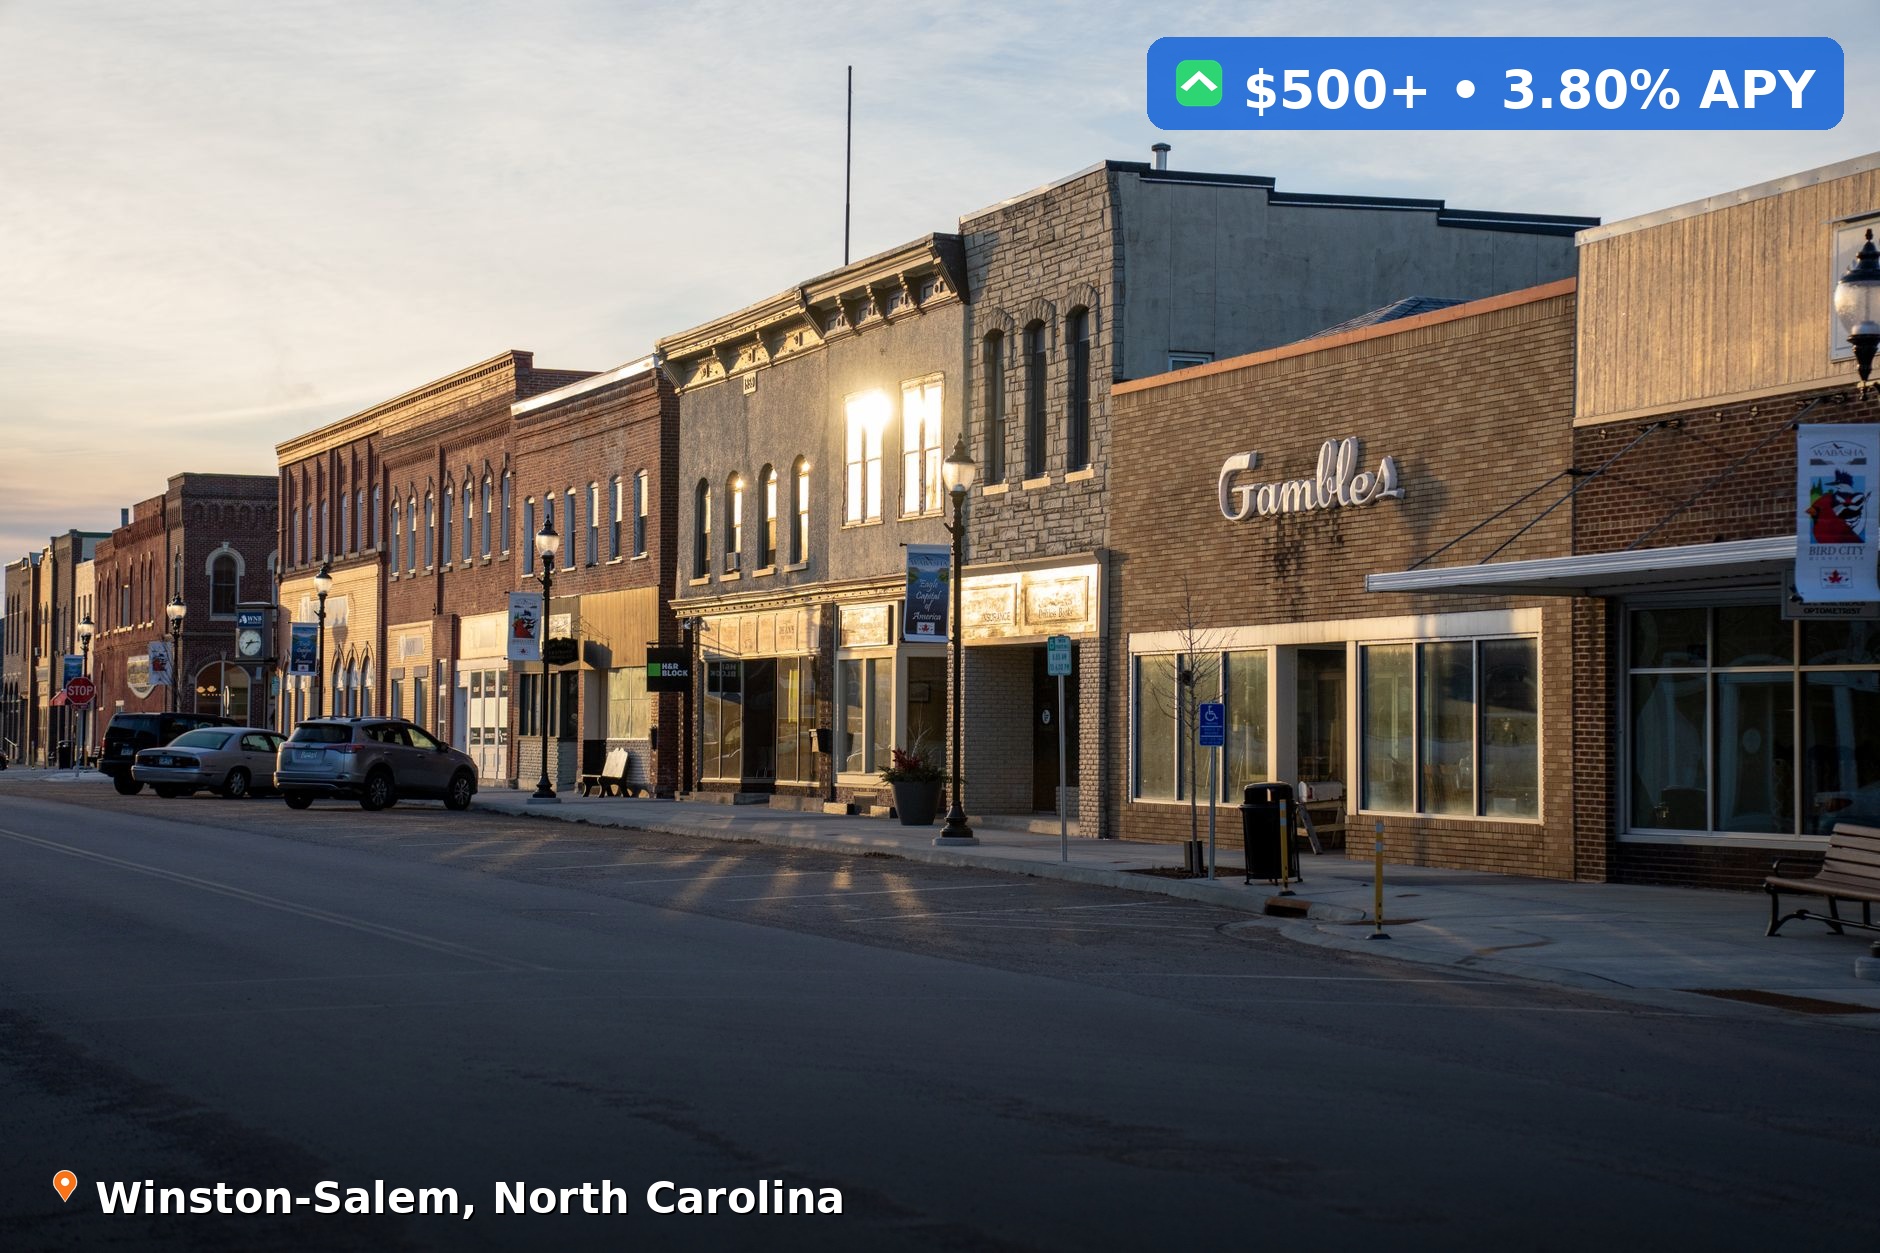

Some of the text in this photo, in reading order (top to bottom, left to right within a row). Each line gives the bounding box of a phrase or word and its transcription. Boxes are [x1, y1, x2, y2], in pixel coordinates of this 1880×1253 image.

[1813, 448, 1865, 457] WABASHA
[1218, 436, 1406, 522] Gambles
[1808, 545, 1866, 556] BIRD CITY
[919, 578, 939, 592] Eagle
[915, 591, 942, 603] Capital
[924, 600, 934, 612] of
[1802, 607, 1862, 615] OPTOMETRIST
[912, 611, 942, 621] America
[661, 662, 679, 670] H&R
[68, 685, 94, 696] STOP
